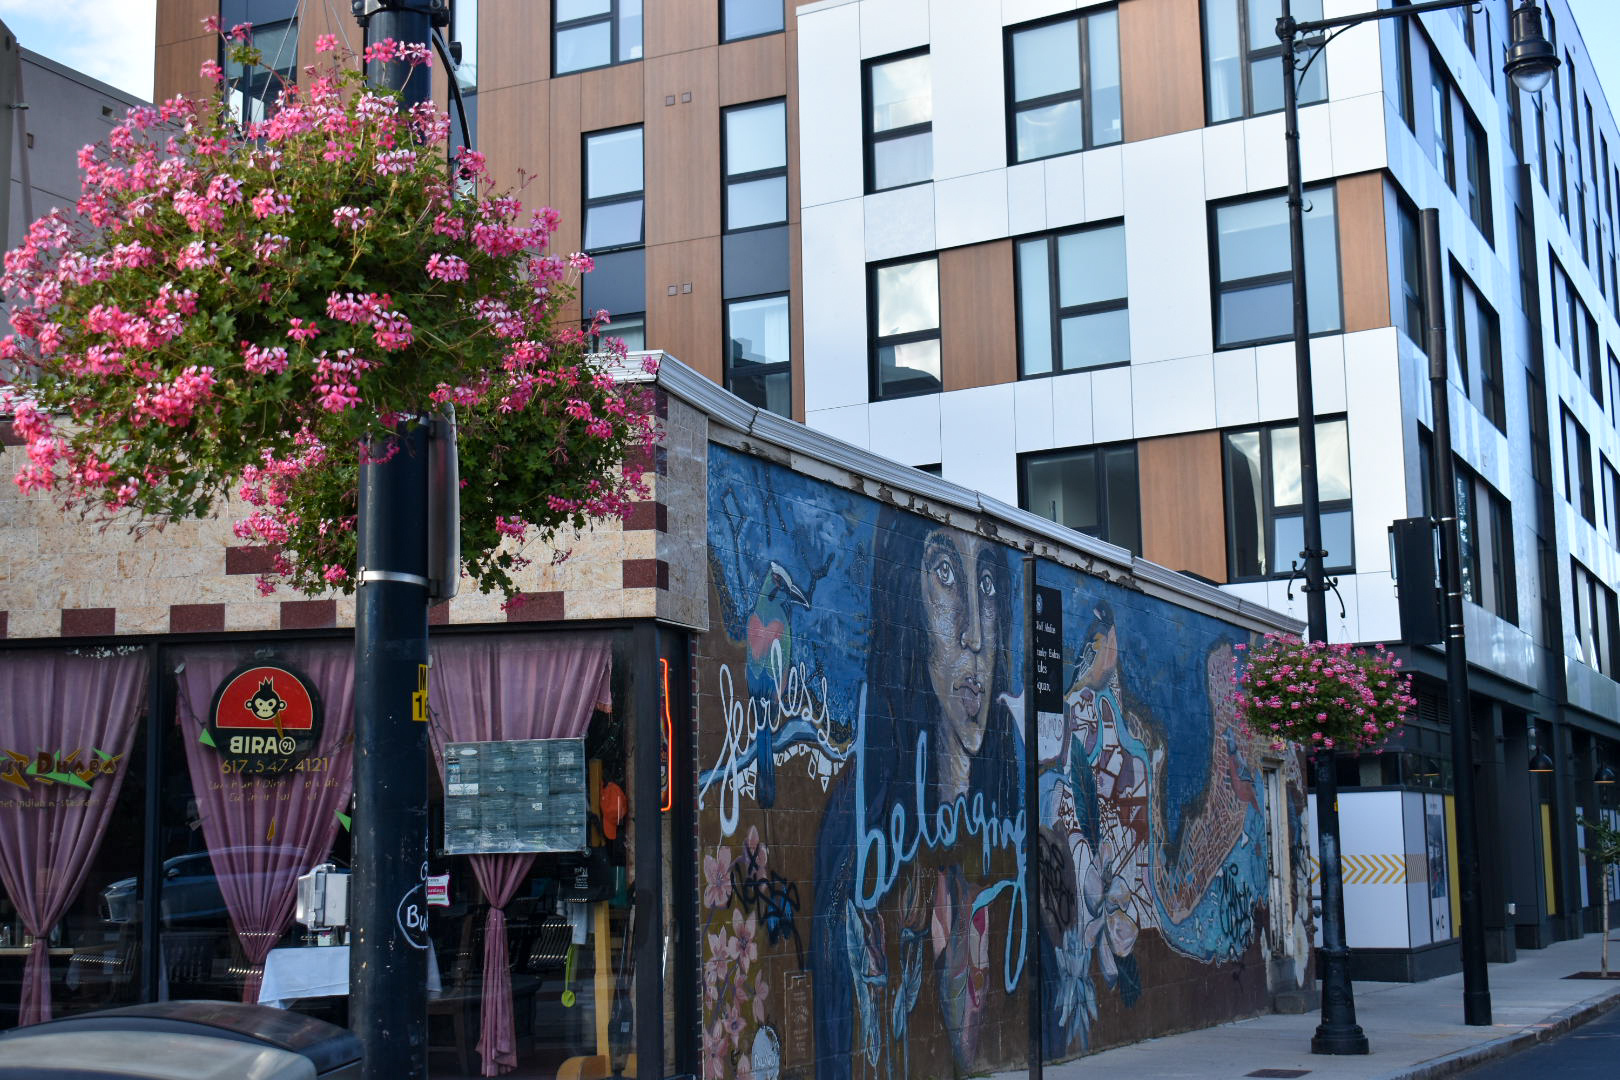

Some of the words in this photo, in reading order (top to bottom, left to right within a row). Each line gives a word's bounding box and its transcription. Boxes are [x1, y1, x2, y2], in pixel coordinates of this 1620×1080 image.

[229, 736, 278, 754] BIRA
[221, 757, 328, 774] 617.547.4121
[855, 681, 1027, 993] belonging
